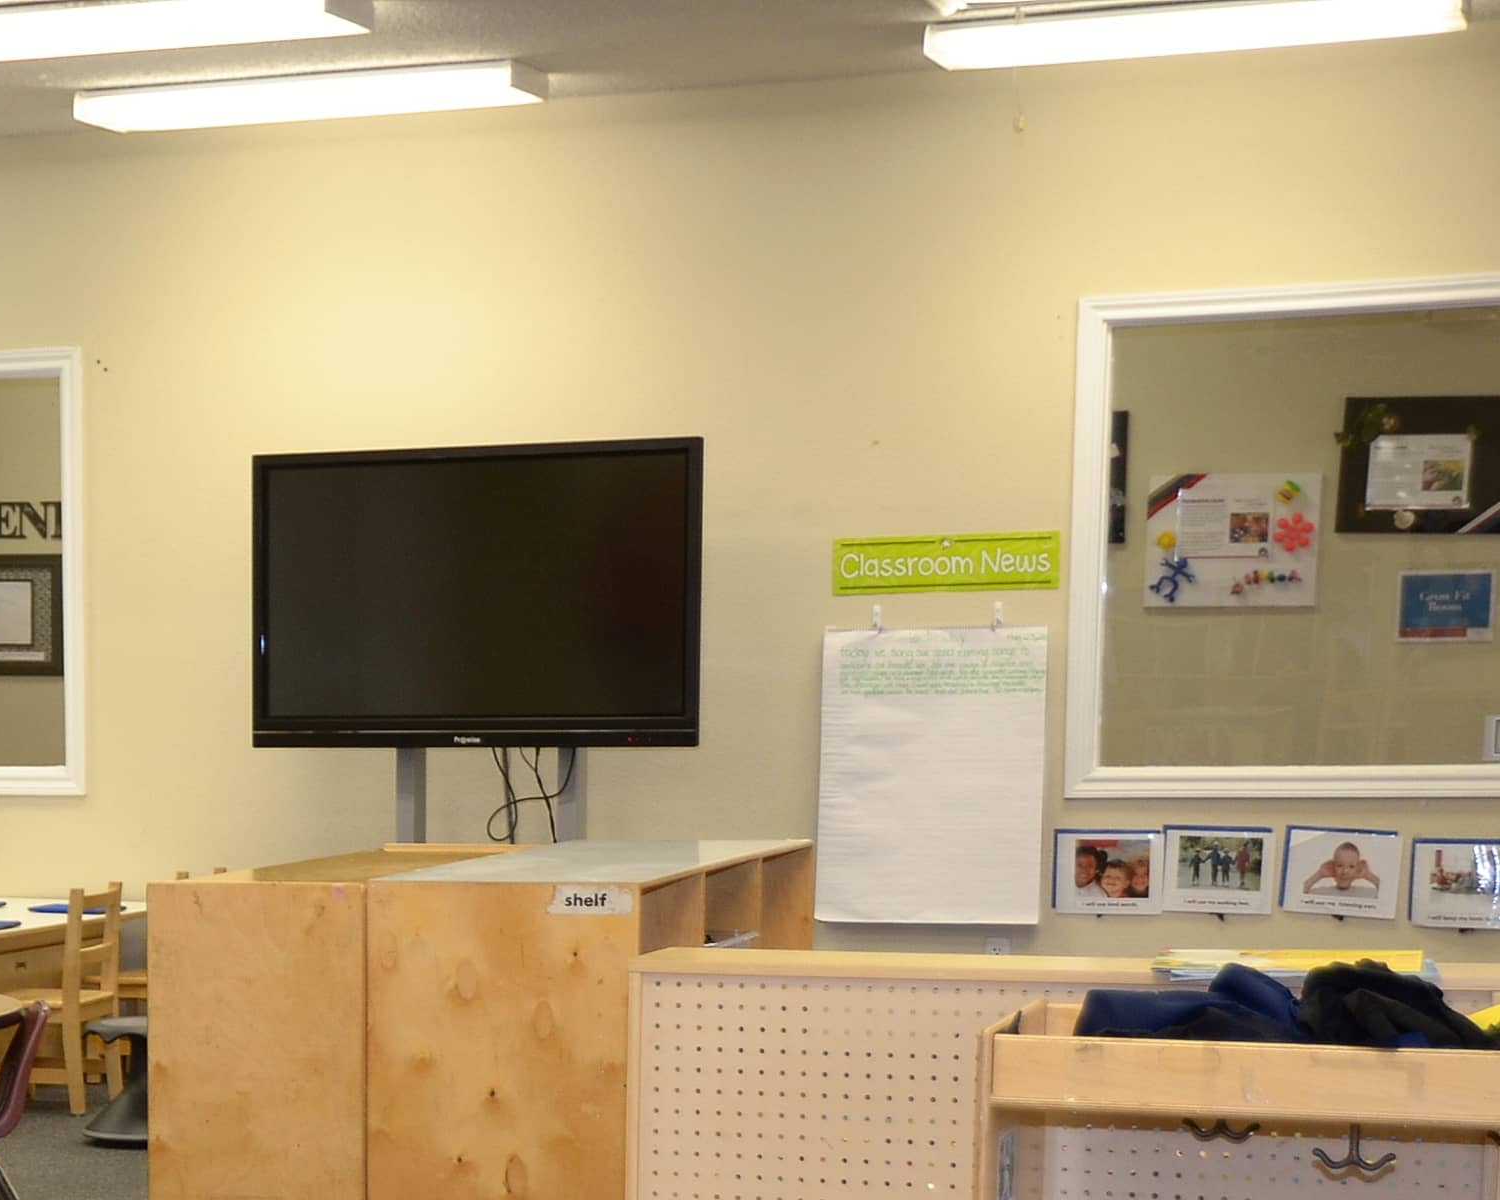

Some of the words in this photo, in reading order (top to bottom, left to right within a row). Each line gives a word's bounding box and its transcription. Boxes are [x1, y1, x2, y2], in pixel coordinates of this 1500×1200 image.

[840, 553, 973, 579] Classroom
[980, 548, 1051, 574] News
[564, 893, 607, 907] shelf
